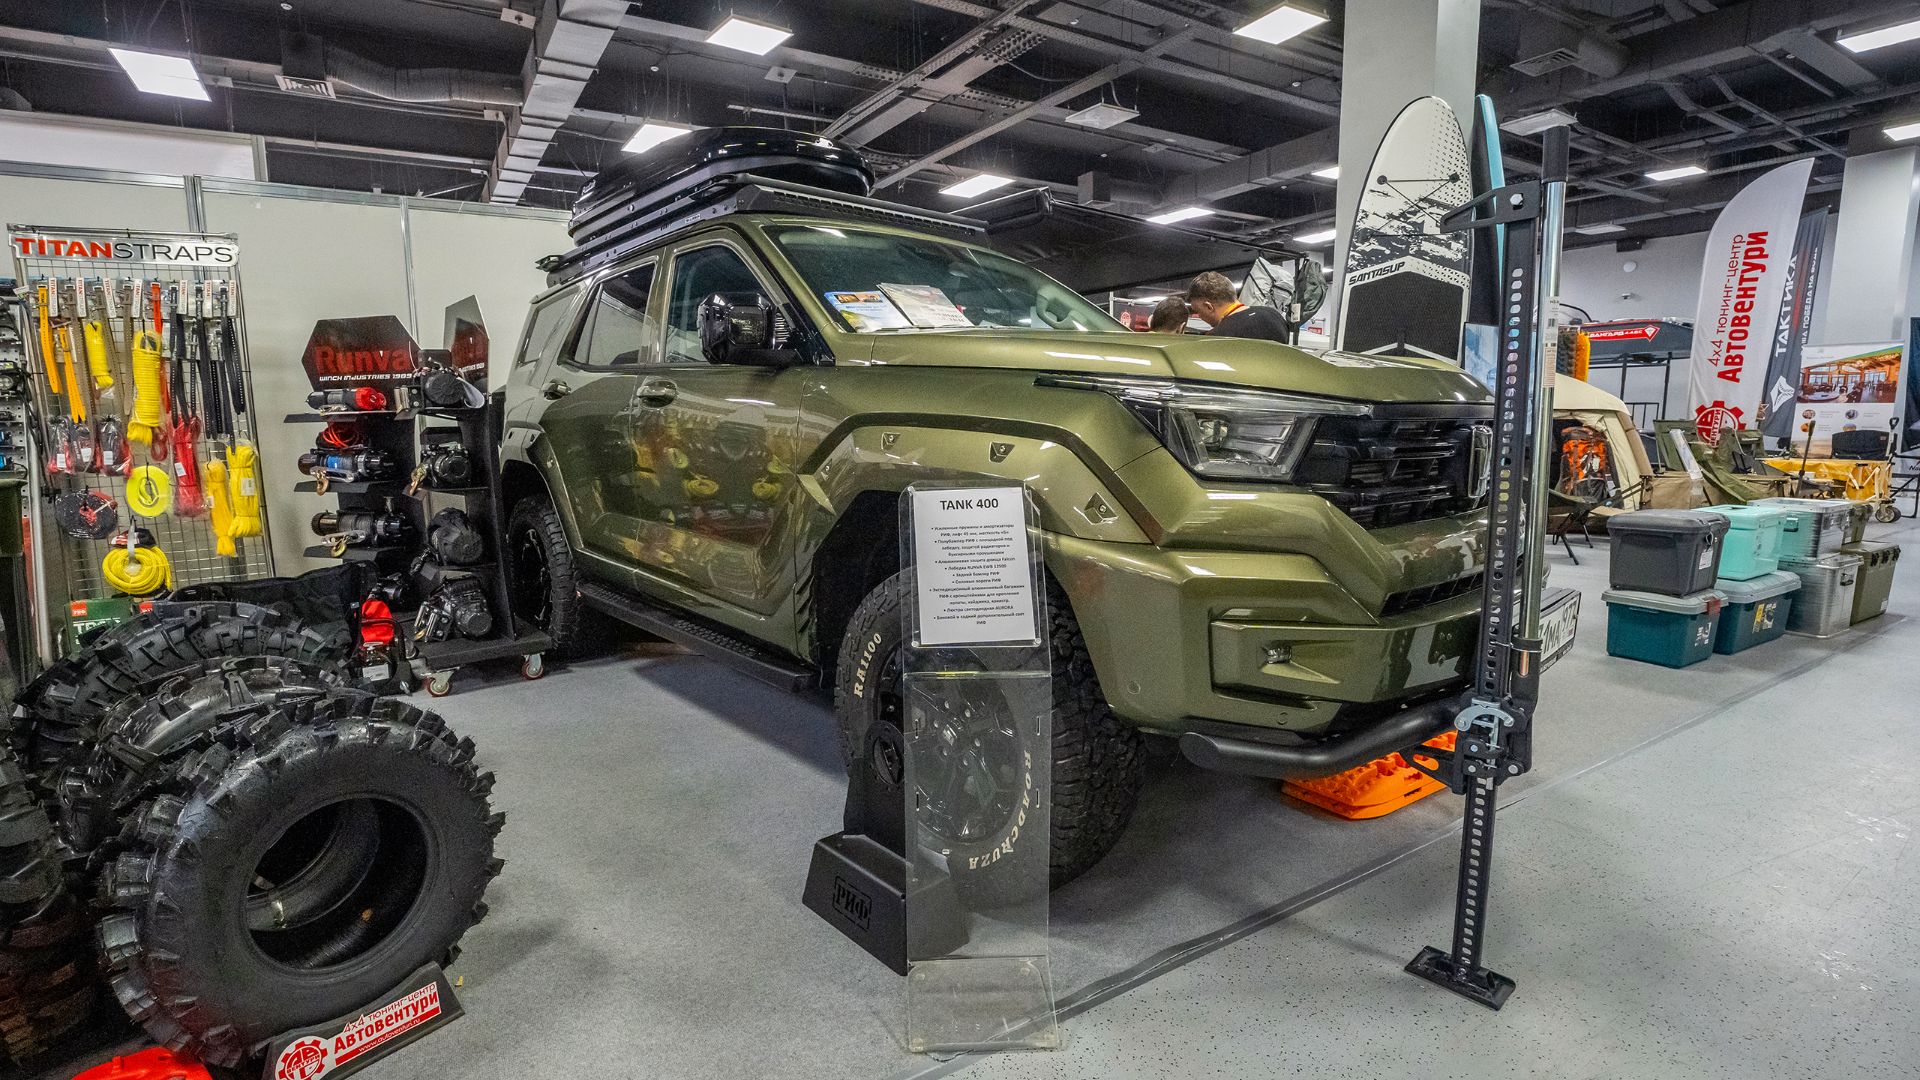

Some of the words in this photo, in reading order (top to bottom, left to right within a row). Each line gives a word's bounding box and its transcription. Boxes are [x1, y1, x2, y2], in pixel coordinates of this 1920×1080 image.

[15, 237, 234, 263] TITANSTRAPS
[1348, 261, 1406, 286] SANTASUP
[1716, 234, 1746, 334] тюнинг-центр
[1776, 254, 1798, 358] ТАКТИКА
[1802, 290, 1813, 329] ПОБЕДА
[314, 346, 411, 374] Runva
[940, 500, 973, 510] TANK
[976, 498, 999, 508] 400
[854, 632, 882, 698] RA1100
[968, 750, 1032, 870] ROADCRUZA
[836, 884, 870, 922] РИФ
[368, 983, 436, 1022] тюнинг-центр
